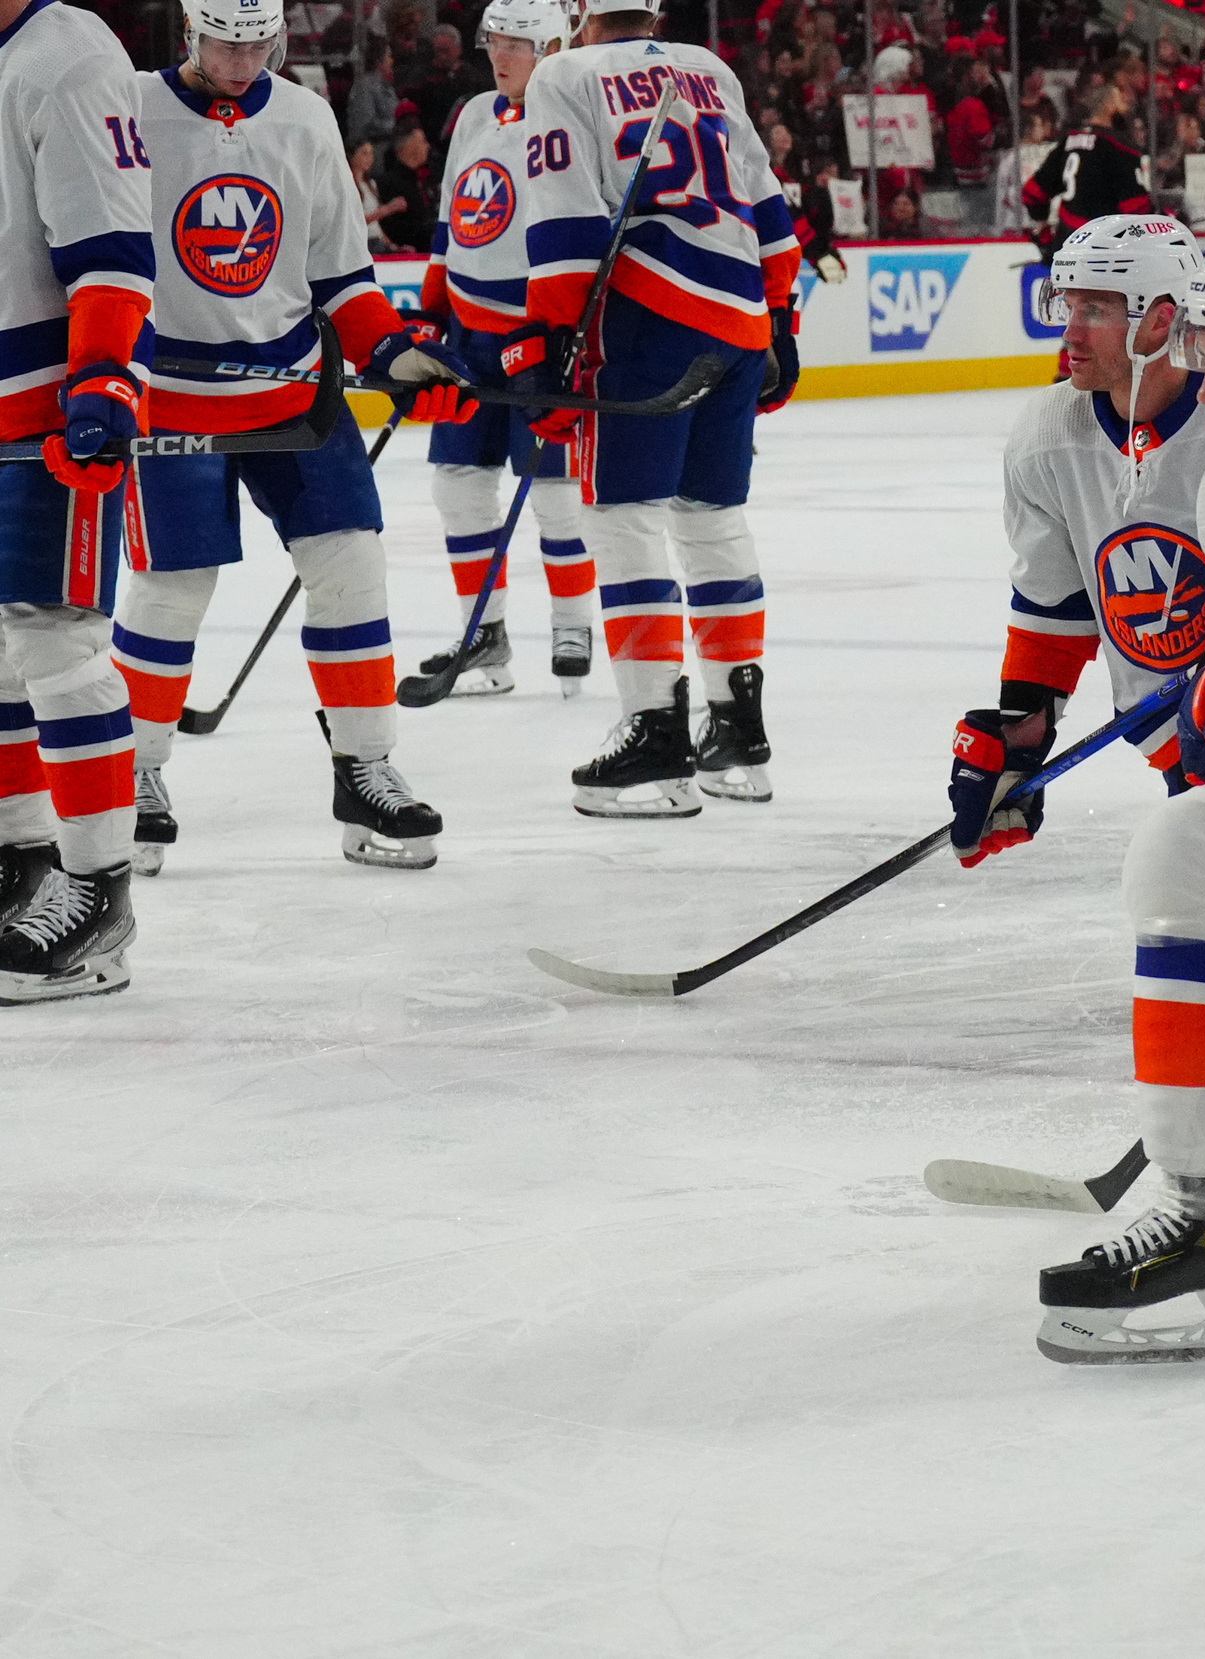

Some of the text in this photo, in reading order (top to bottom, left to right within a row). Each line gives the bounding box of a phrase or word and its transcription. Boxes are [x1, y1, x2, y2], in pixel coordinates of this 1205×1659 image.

[104, 116, 152, 169] 18
[527, 128, 572, 179] 20
[614, 110, 758, 232] 20
[202, 186, 268, 240] NY
[1144, 222, 1176, 235] UBS
[190, 244, 271, 283] ISLANDERS
[870, 270, 947, 337] SAP
[79, 427, 103, 438] CCM
[130, 435, 214, 456] CCM
[79, 518, 91, 576] BAUER
[1108, 539, 1184, 606] NY
[1061, 1321, 1095, 1337] CCM
